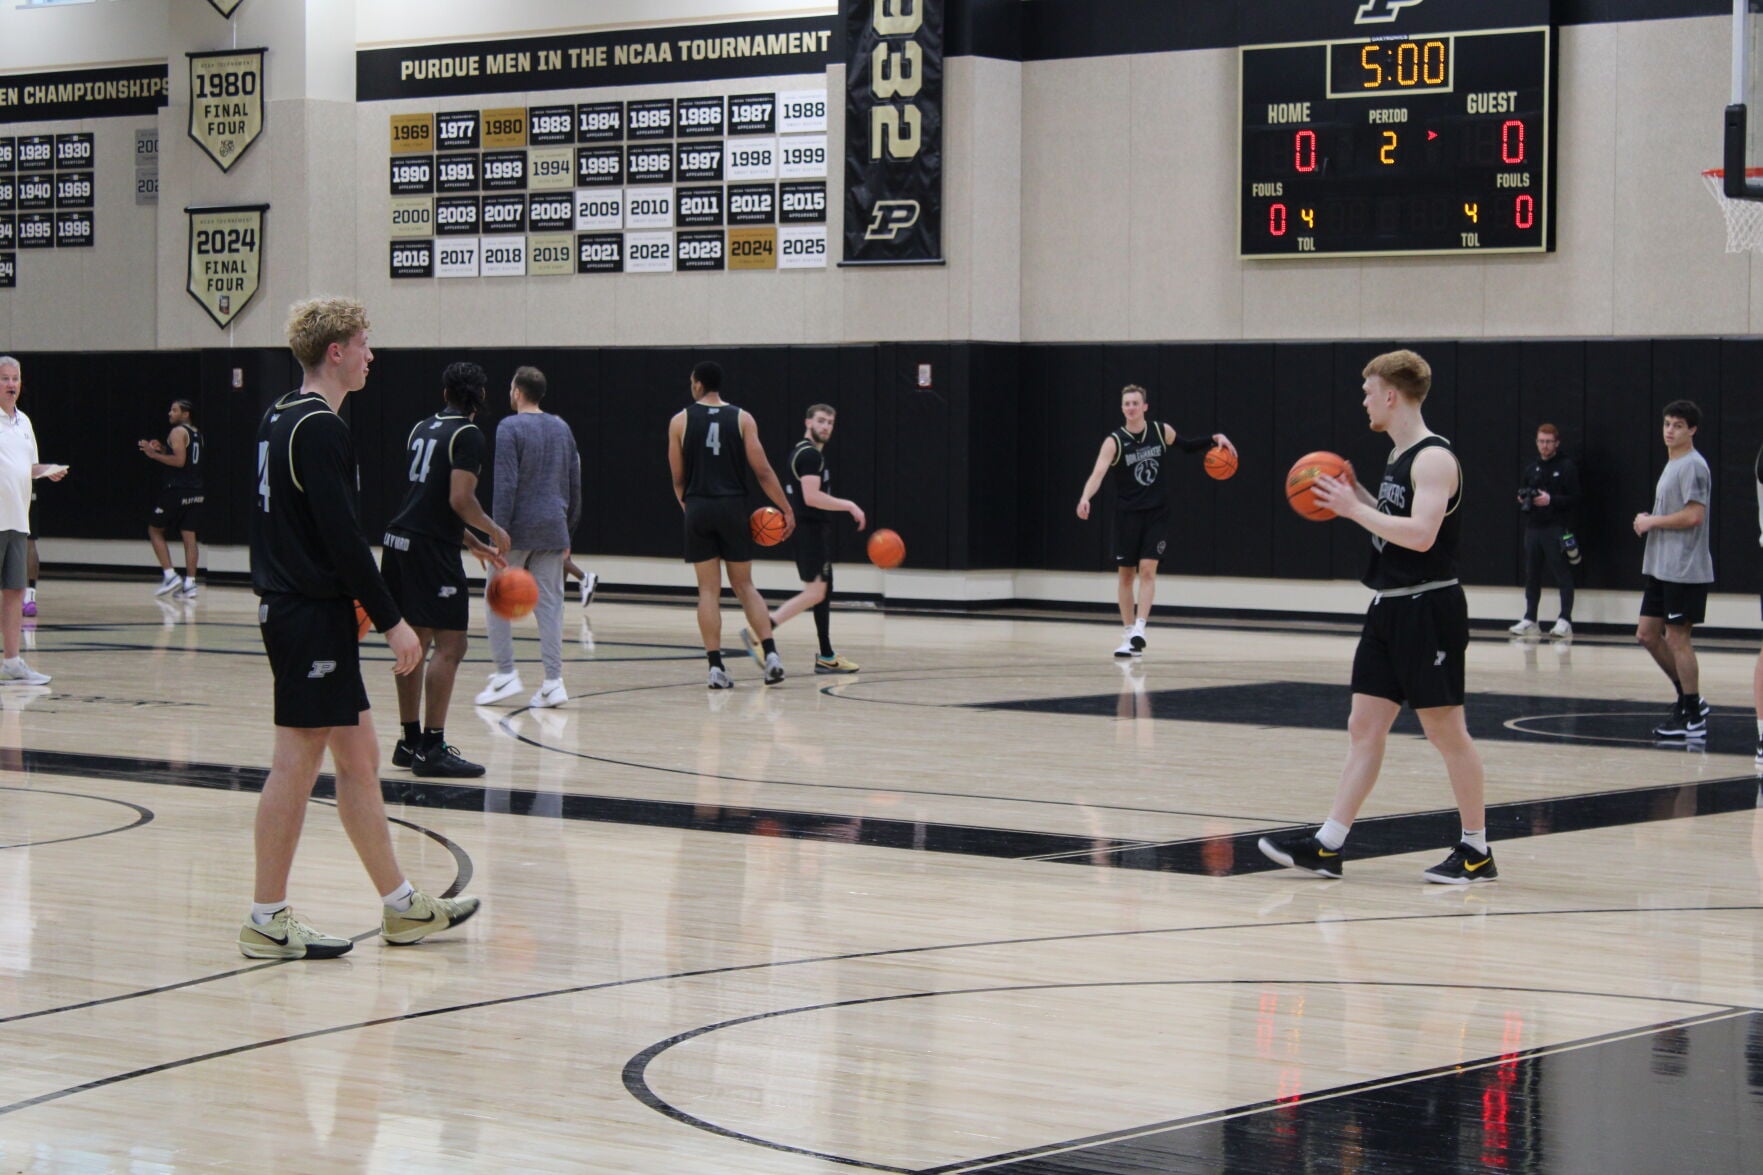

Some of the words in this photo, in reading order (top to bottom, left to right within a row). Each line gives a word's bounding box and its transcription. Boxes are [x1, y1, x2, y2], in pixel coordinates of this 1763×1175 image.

[400, 55, 480, 80] PURDUE
[486, 52, 531, 75] MEN
[537, 50, 563, 71] IN
[568, 46, 607, 68] THE
[613, 41, 672, 65] NCAA
[678, 30, 832, 59] TOURNAMENT
[1361, 41, 1445, 88] 5:00
[196, 71, 256, 98] 1980
[205, 103, 248, 118] FINAL
[784, 102, 825, 119] 1988
[1467, 92, 1517, 113] GUEST
[580, 111, 620, 132] 1984
[630, 110, 671, 128] 1985
[680, 107, 721, 126] 1986
[732, 104, 772, 123] 1987
[1268, 103, 1311, 124] HOME
[1369, 108, 1408, 123] PERIOD
[208, 121, 245, 136] FOUR
[394, 125, 429, 140] 1969
[440, 121, 474, 139] 1977
[486, 119, 522, 135] 1980
[532, 116, 571, 134] 1983
[58, 142, 90, 158] 1930
[1379, 131, 1397, 164] 2
[1502, 120, 1524, 164] 0
[19, 144, 50, 161] 1928
[731, 150, 771, 167] 1998
[784, 148, 825, 165] 1999
[1295, 130, 1316, 172] 0
[533, 160, 570, 176] 1994
[580, 156, 620, 175] 1995
[630, 154, 670, 172] 1996
[680, 152, 720, 170] 1997
[393, 167, 429, 183] 1990
[440, 164, 474, 181] 1991
[485, 161, 523, 179] 1993
[1497, 173, 1530, 188] FOULS
[20, 183, 50, 199] 1940
[58, 181, 90, 198] 1969
[1252, 183, 1283, 197] FOULS
[579, 199, 620, 218] 2009
[631, 199, 669, 215] 2010
[681, 197, 719, 215] 2011
[731, 195, 771, 213] 2012
[783, 193, 825, 210] 2015
[393, 209, 430, 224] 2000
[438, 206, 476, 223] 2003
[484, 205, 523, 221] 2007
[531, 203, 571, 220] 2008
[1270, 203, 1286, 236] 0
[1301, 208, 1314, 228] 4
[1464, 202, 1478, 223] 4
[1515, 195, 1533, 229] 0
[20, 222, 51, 238] 1995
[58, 221, 90, 236] 1996
[197, 229, 255, 254] 2024
[783, 239, 825, 255] 2025
[1297, 237, 1316, 251] TOL
[1461, 232, 1480, 247] TOL
[485, 248, 522, 264] 2018
[533, 247, 570, 262] 2019
[581, 242, 620, 261] 2021
[630, 244, 670, 259] 2022
[679, 242, 722, 259] 2023
[731, 240, 773, 257] 2024
[393, 250, 429, 266] 2016
[440, 250, 474, 265] 2017
[206, 261, 247, 274] FINAL
[208, 278, 244, 291] FOUR
[706, 422, 721, 456] 4
[192, 442, 199, 464] 0
[409, 438, 437, 483] 24
